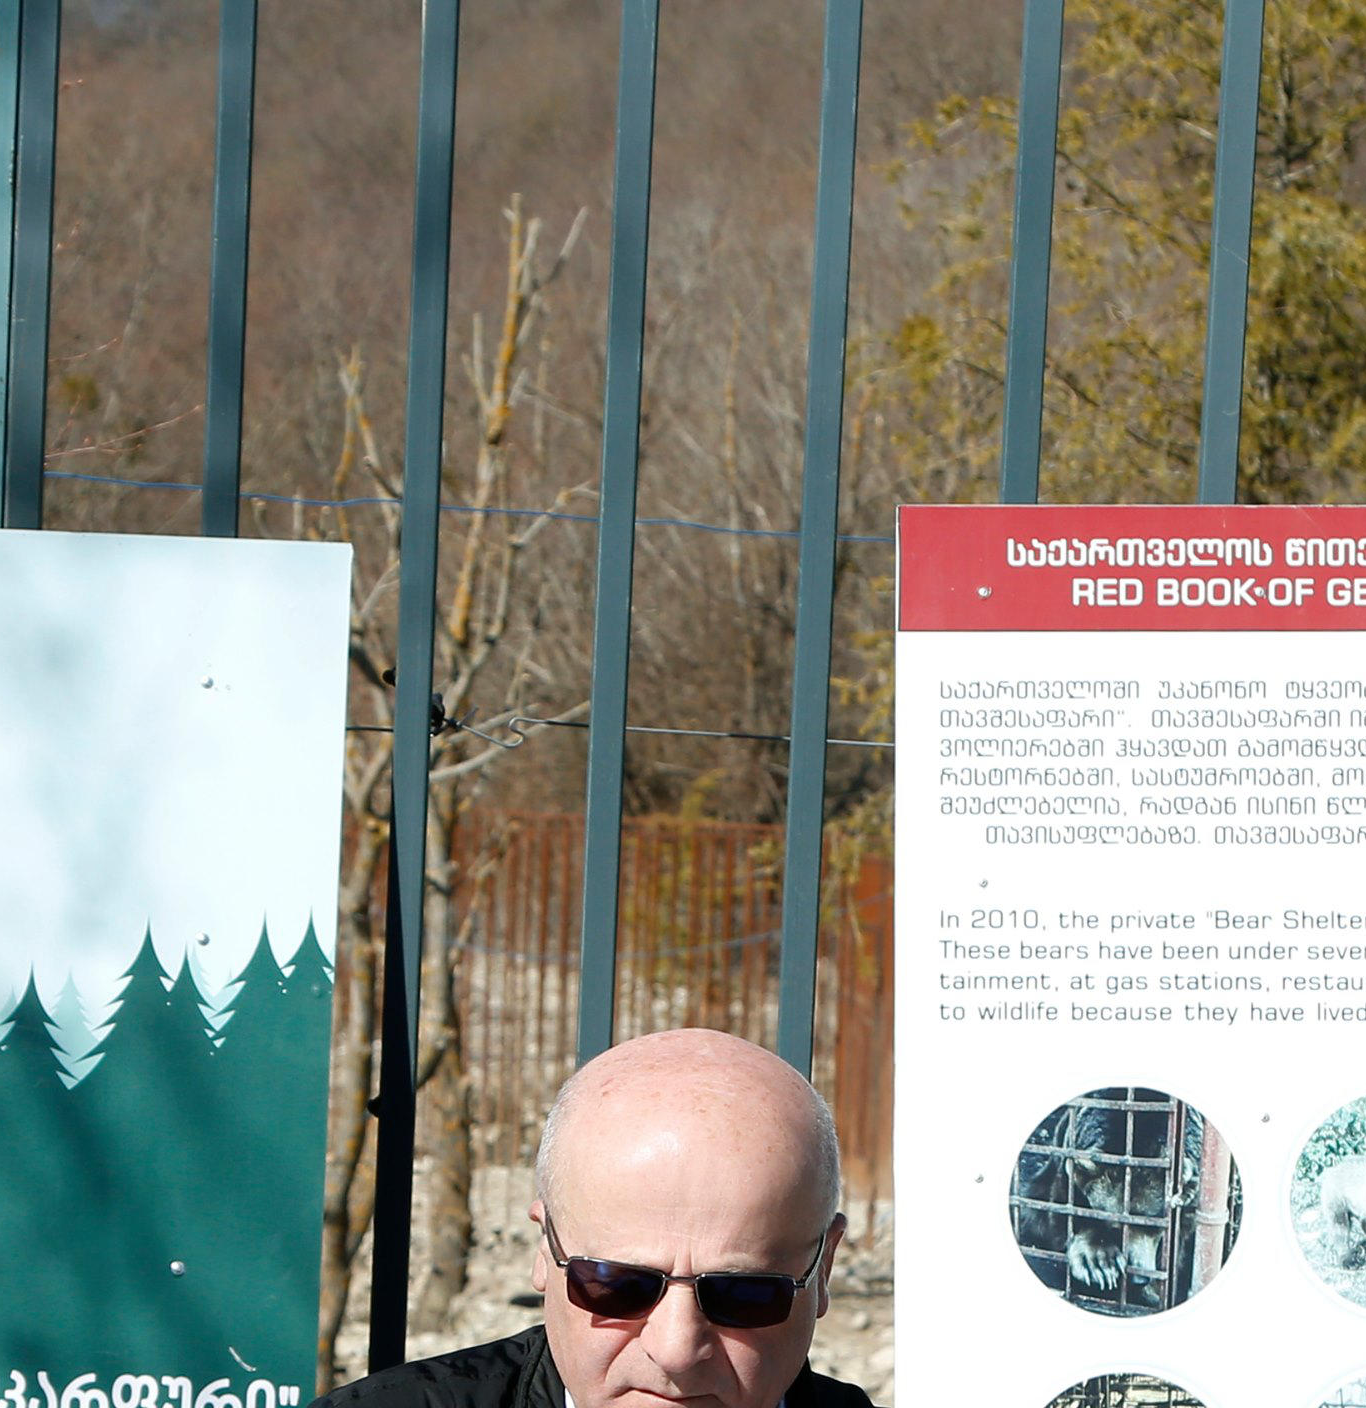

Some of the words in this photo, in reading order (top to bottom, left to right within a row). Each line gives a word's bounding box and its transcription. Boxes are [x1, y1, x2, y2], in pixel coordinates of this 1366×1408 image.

[1007, 538, 1273, 567] საქართველოს
[1072, 578, 1143, 606] RED
[1157, 577, 1255, 606] BOOK
[1268, 577, 1314, 606] OF
[940, 909, 960, 929] In
[970, 908, 1047, 931] 2010,
[1058, 910, 1100, 930] the
[1110, 910, 1196, 934] private
[938, 939, 1011, 960] These
[1019, 940, 1089, 960] bears
[1098, 940, 1153, 960] have
[1162, 940, 1219, 961] been
[1228, 940, 1299, 961] under
[939, 972, 1059, 992] tainment,
[1069, 973, 1096, 991] at
[1105, 975, 1149, 996] gas
[1159, 971, 1270, 993] stations,
[938, 1003, 966, 1021] to
[977, 1000, 1059, 1021] wildlife
[1071, 1001, 1173, 1022] because
[1184, 1001, 1239, 1026] they
[1250, 1001, 1305, 1022] have
